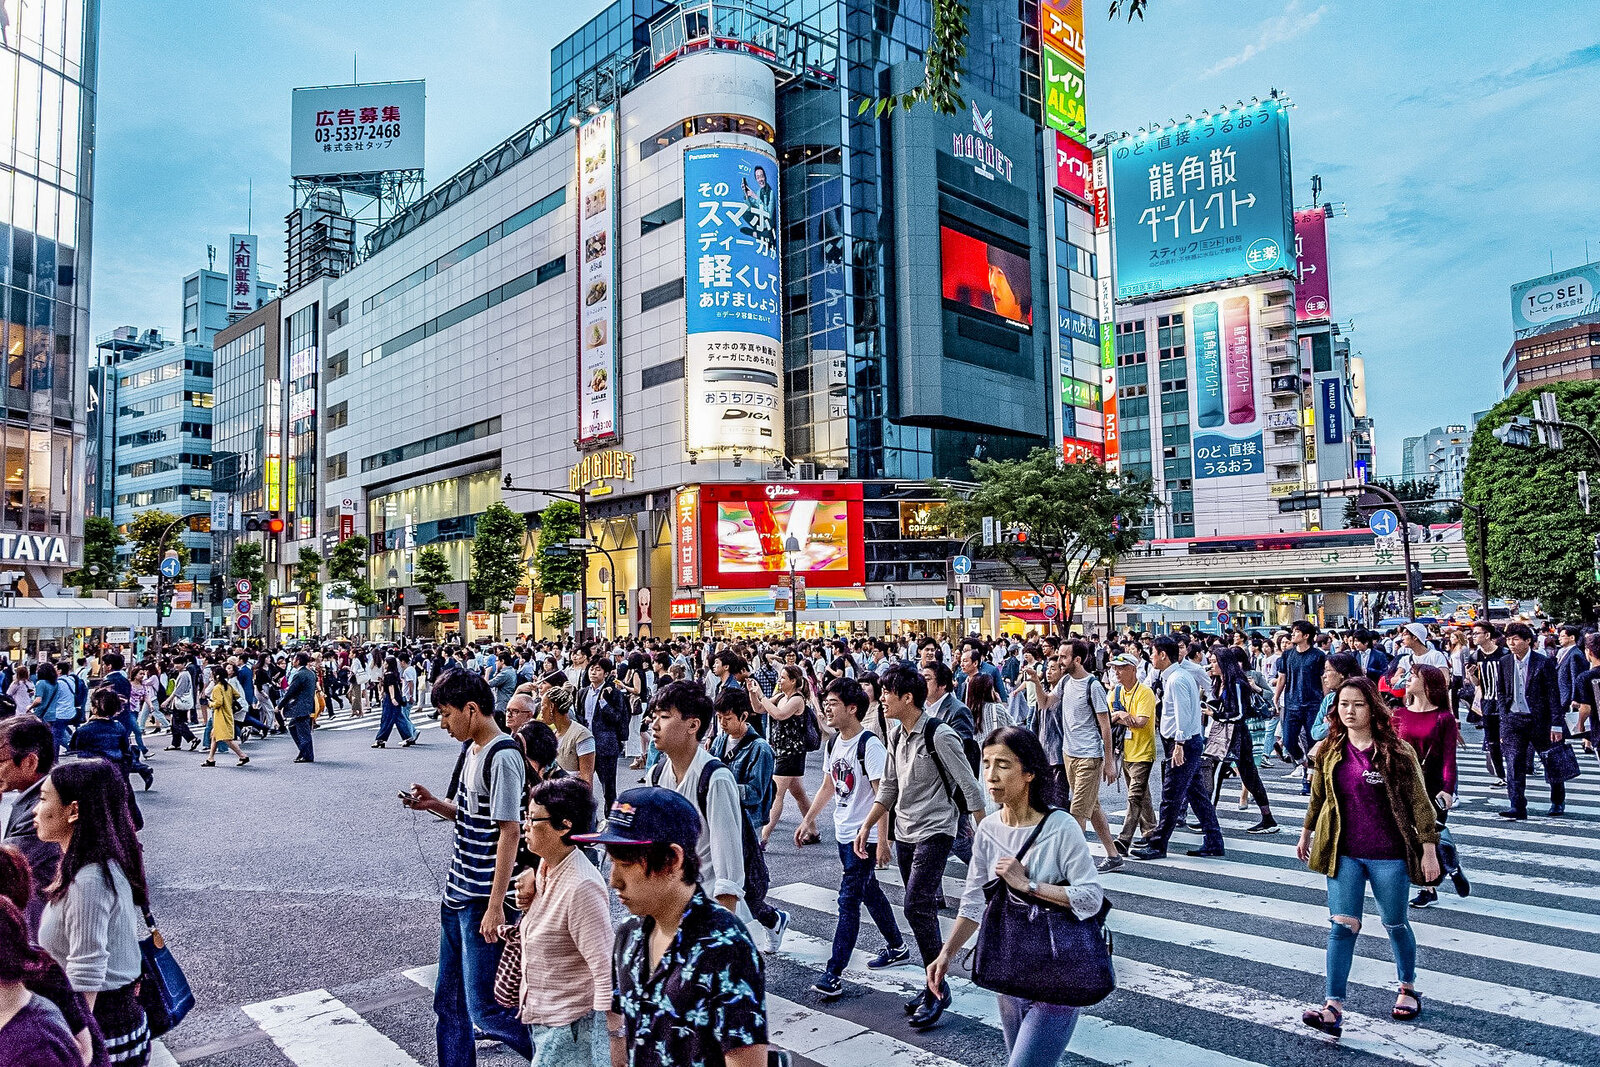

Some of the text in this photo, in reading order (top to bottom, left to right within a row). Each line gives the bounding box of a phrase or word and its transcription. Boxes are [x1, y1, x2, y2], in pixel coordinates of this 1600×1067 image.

[1050, 12, 1086, 57] アコム
[1048, 57, 1083, 98] レイク
[315, 106, 400, 126] 広告募集
[1047, 87, 1085, 127] ALSA
[314, 123, 401, 142] 03-5337-2468
[1116, 109, 1270, 160] のど、直接、うるおう
[322, 139, 393, 153] 株式会社タップ
[688, 152, 720, 161] Panasonic
[952, 132, 1013, 183] MAGNET
[1057, 148, 1093, 182] アイフル
[1148, 145, 1238, 202] 龍角散
[697, 182, 730, 198] その
[1097, 198, 1108, 228] アイフル
[1137, 188, 1258, 243] ダイレクト
[1149, 241, 1198, 260] スティック
[1202, 239, 1222, 250] ミント
[1248, 248, 1279, 264] 生薬
[234, 240, 251, 296] 大和証券
[698, 254, 778, 296] 軽くして
[699, 291, 779, 316] あげましょう!
[1307, 301, 1326, 312] 生薬
[1528, 283, 1583, 307] TOSEI
[1529, 297, 1584, 316] トーセイ株式会社
[1328, 382, 1336, 410] MIZUHO
[592, 409, 600, 420] 7F
[722, 409, 770, 421] DIGA
[1106, 413, 1116, 440] アコム
[1197, 441, 1262, 460] のど、直接、
[569, 451, 635, 492] MAGNET
[1204, 458, 1253, 475] うるおう
[765, 485, 800, 499] Glico
[0, 533, 68, 562] TAYA
[681, 506, 694, 584] 天津甘栗
[1320, 552, 1339, 563] JR
